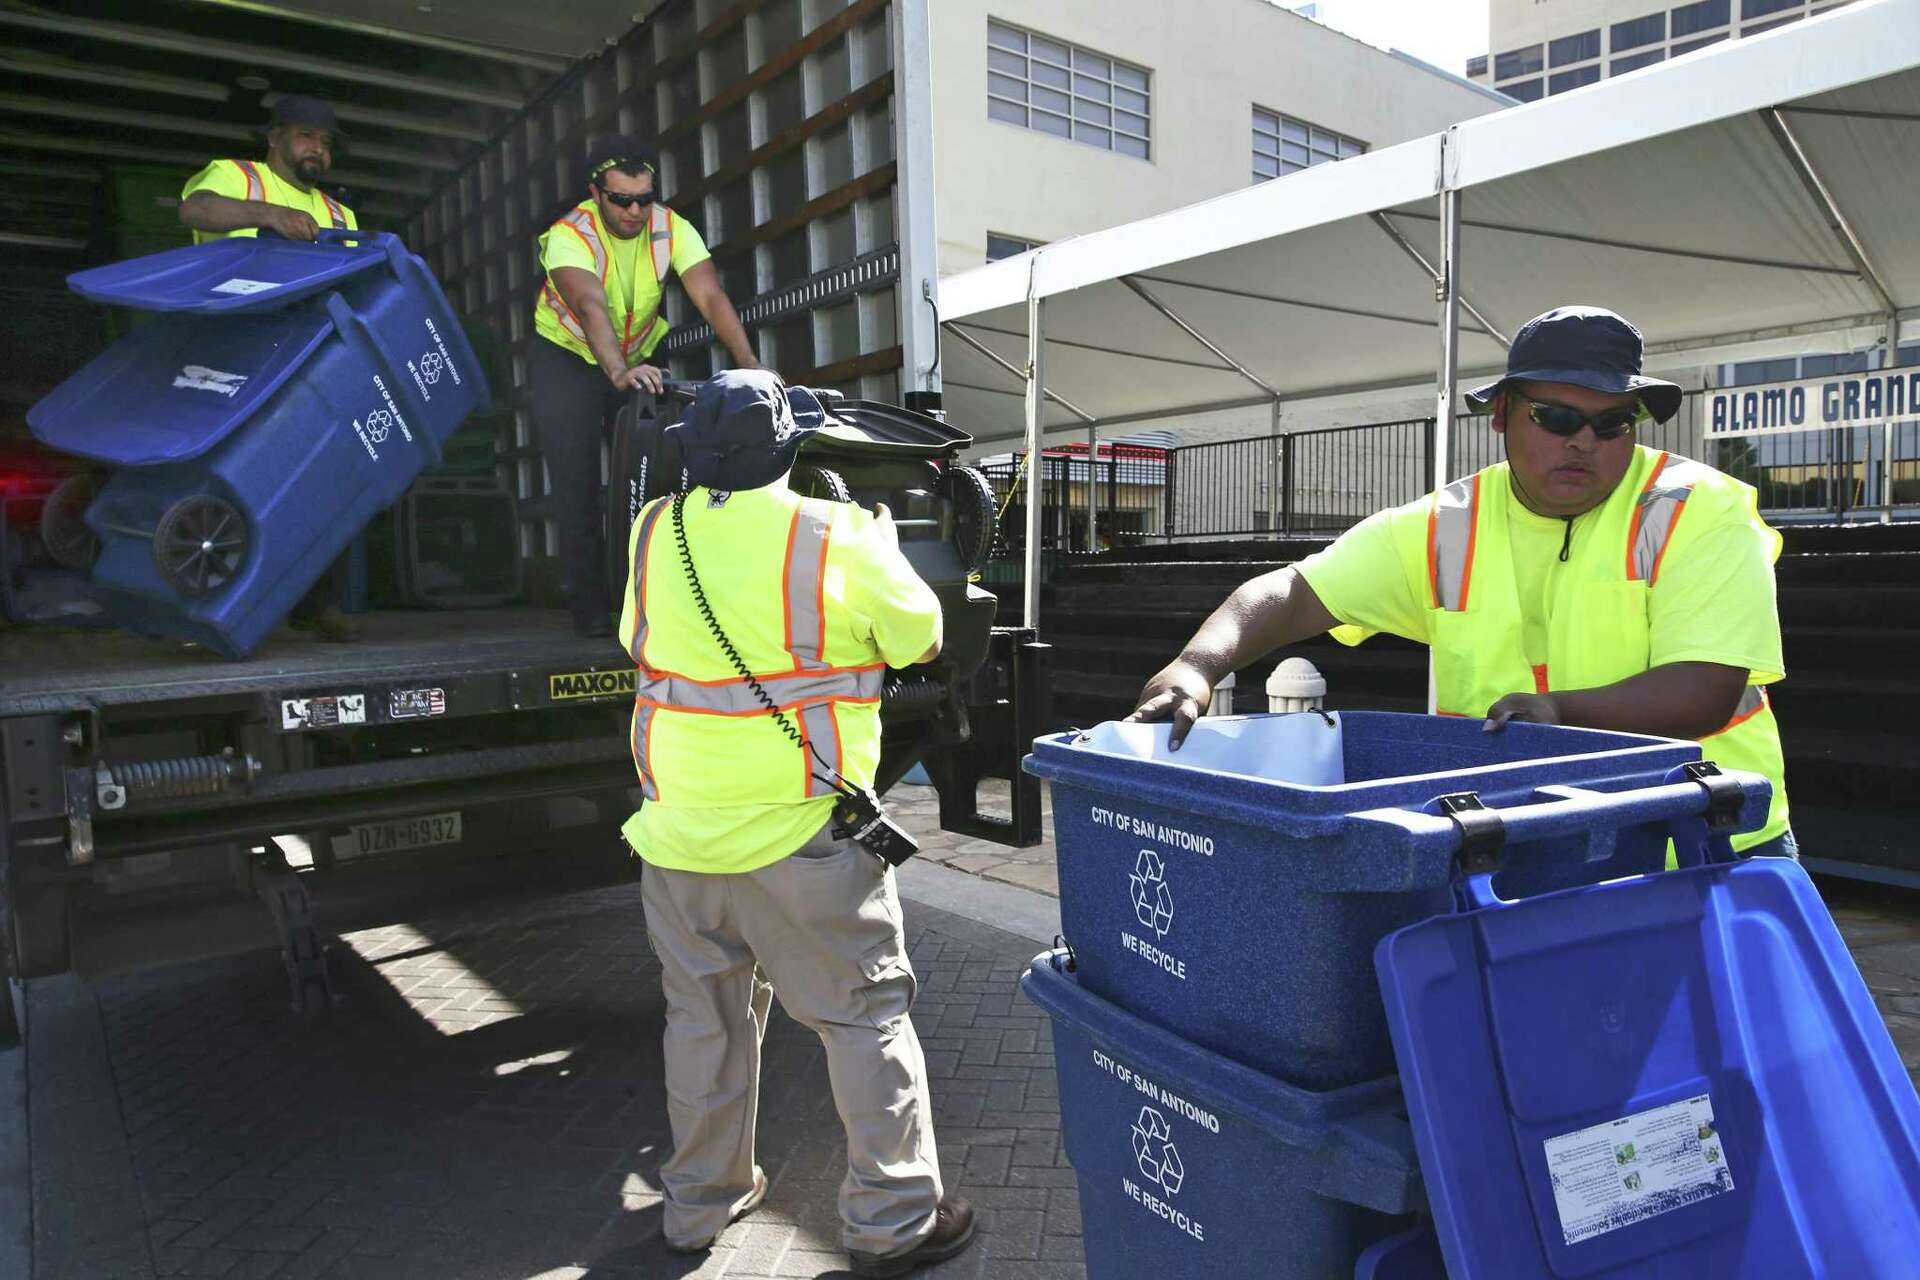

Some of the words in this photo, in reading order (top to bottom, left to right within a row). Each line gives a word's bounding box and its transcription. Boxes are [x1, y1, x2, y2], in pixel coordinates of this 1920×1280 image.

[425, 318, 436, 334] CITY
[433, 333, 441, 343] OF
[438, 343, 448, 358] SAN
[407, 360, 416, 374] WE
[413, 372, 430, 402] RECYCLE
[373, 375, 385, 391] CITY
[382, 390, 390, 400] OF
[388, 400, 398, 415] SAN
[396, 414, 412, 442] ANTONIO
[1712, 386, 1806, 433] ALAMO
[353, 419, 361, 433] WE
[360, 431, 379, 462] RECYCLE
[638, 455, 648, 509] Antonio
[552, 671, 636, 698] MAXON
[1092, 806, 1114, 828] CITY
[1116, 813, 1131, 832] OF
[1132, 818, 1156, 840] SAN
[1158, 825, 1214, 857] ANTONIO
[1121, 931, 1138, 952] WE
[1139, 940, 1186, 980] RECYCLE
[1093, 1050, 1115, 1074] CITY
[1117, 1064, 1132, 1084] OF
[1134, 1074, 1158, 1100] SAN
[1161, 1089, 1220, 1134] ANTONIO
[1122, 1177, 1141, 1202] WE
[1143, 1192, 1204, 1242] RECYCLE
